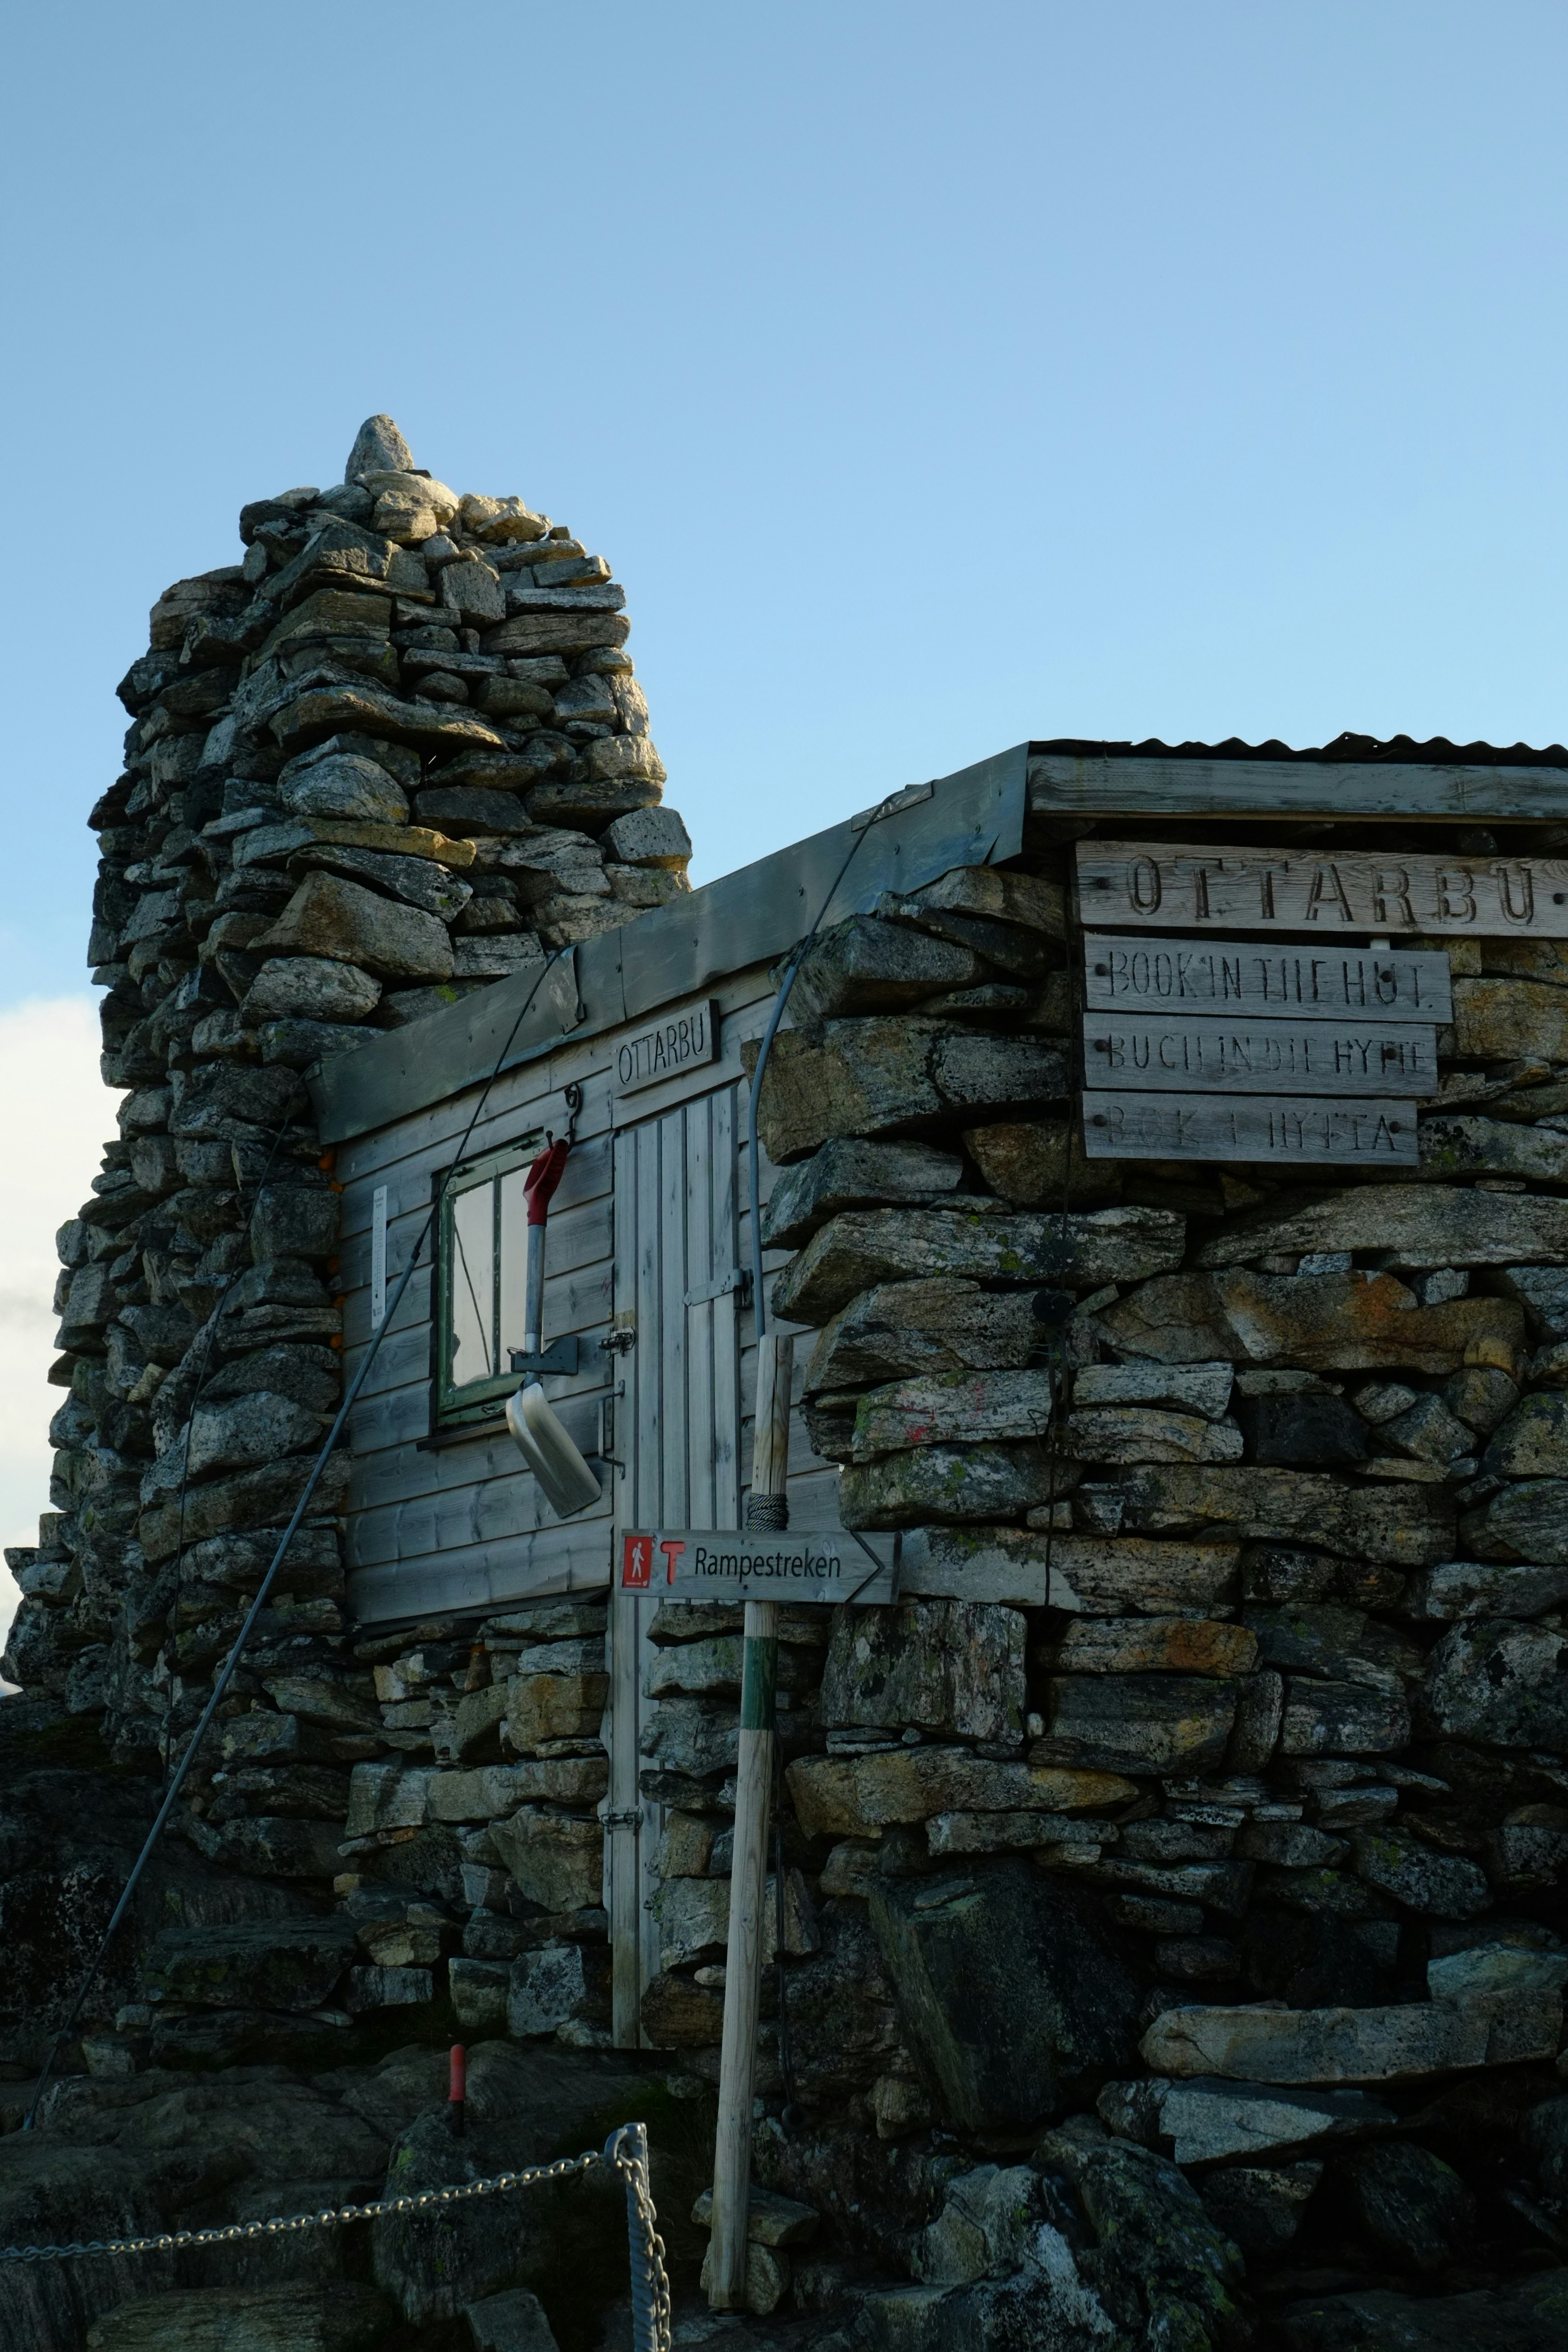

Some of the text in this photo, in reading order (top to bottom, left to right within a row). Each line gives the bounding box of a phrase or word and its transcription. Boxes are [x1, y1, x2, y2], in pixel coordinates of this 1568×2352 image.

[1127, 854, 1534, 926] OTTARBU
[1109, 951, 1196, 998] BOOK
[1209, 956, 1241, 1000] IN
[1253, 958, 1329, 1003] THE
[619, 1013, 704, 1085] OTTARBU
[695, 1547, 841, 1583] Rampestreken
